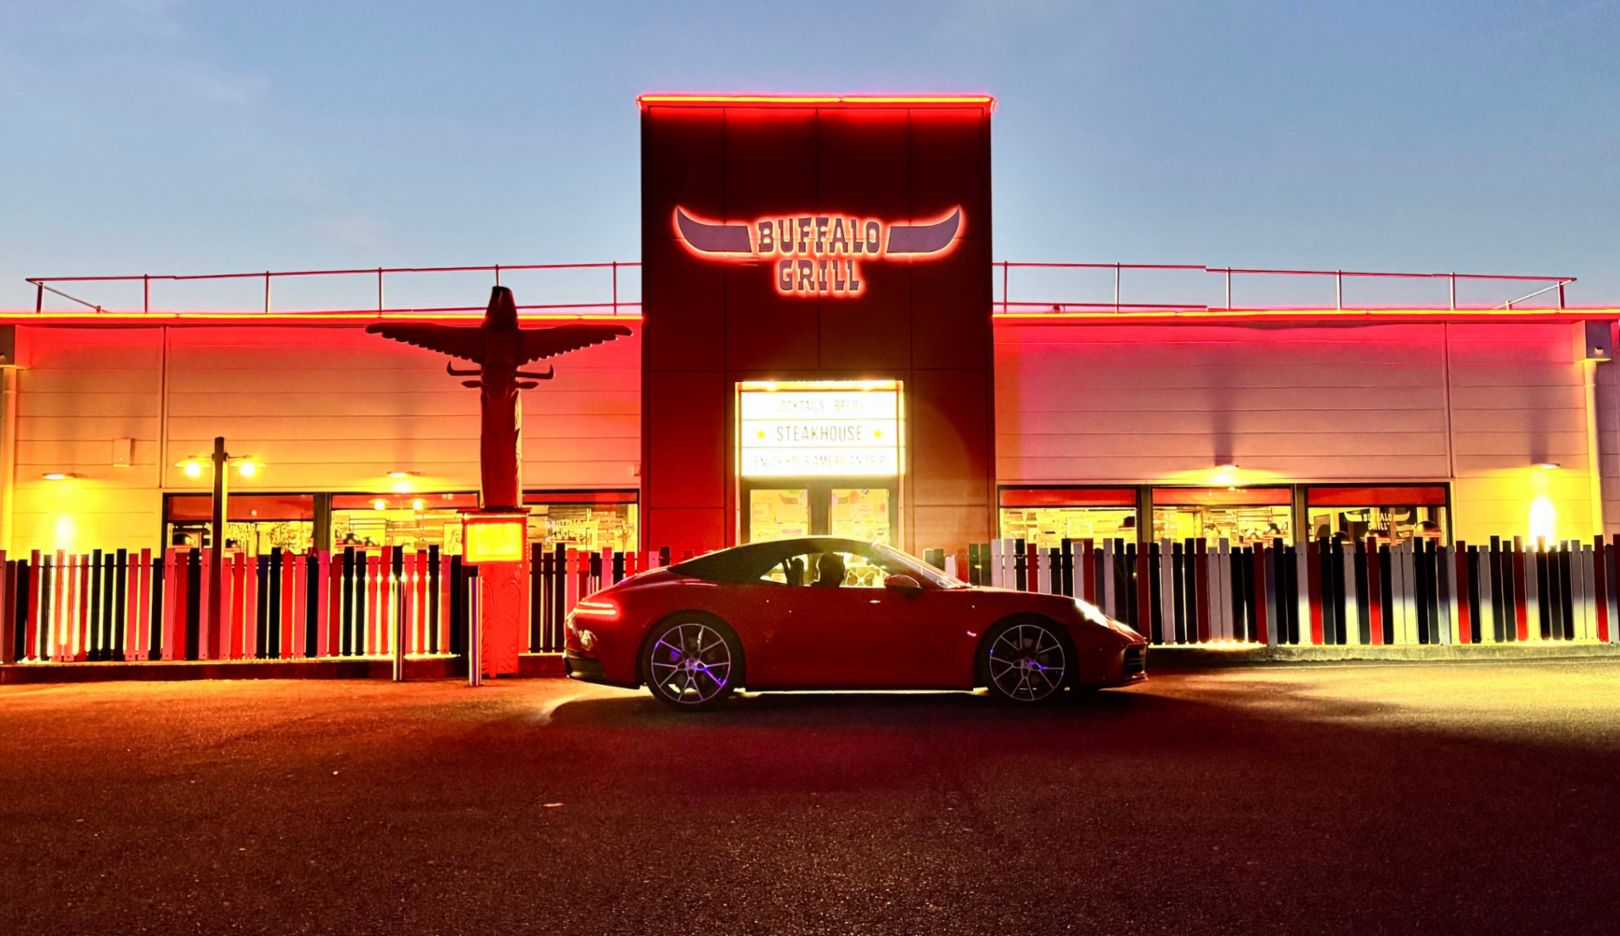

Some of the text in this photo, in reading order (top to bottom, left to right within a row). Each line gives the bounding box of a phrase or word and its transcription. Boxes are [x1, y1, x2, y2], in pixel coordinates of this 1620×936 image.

[757, 216, 881, 254] BUFFALO
[778, 259, 861, 292] GRILL
[776, 425, 864, 442] STEAKHOUSE
